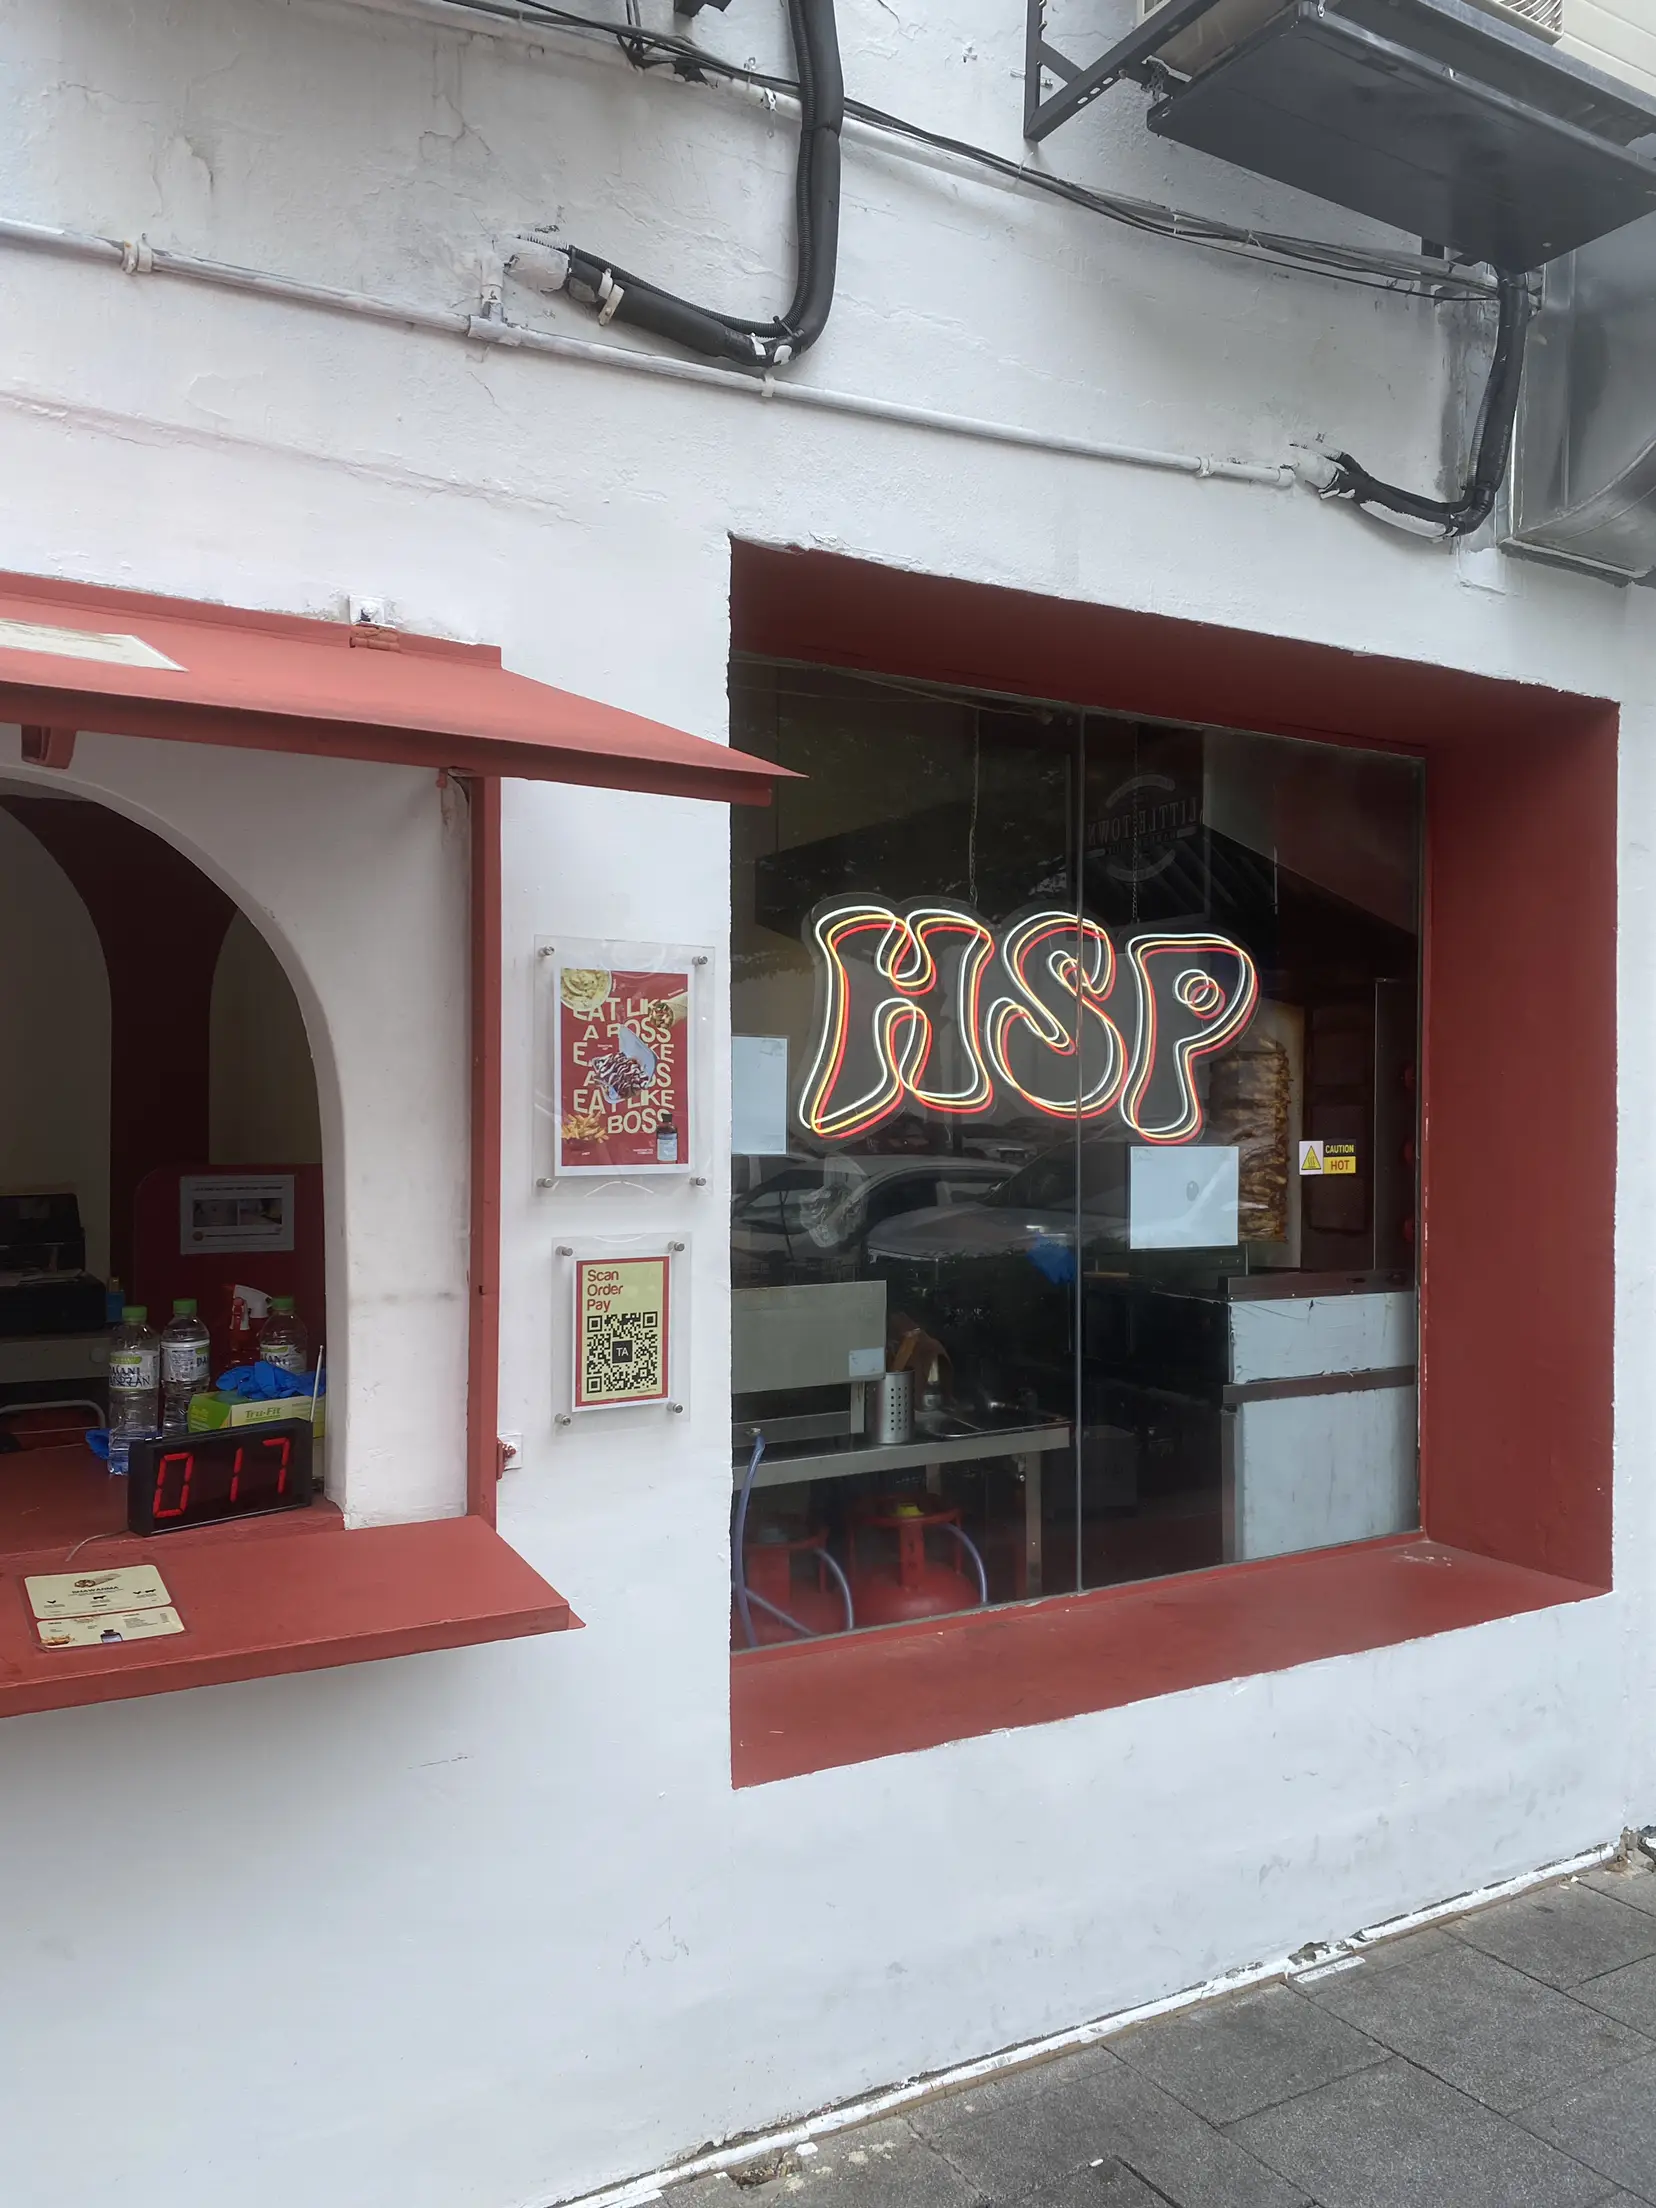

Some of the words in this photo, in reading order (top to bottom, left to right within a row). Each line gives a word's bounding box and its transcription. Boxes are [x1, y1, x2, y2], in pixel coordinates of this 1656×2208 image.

[799, 905, 1258, 1145] HSP
[583, 1024, 600, 1041] A
[1325, 1144, 1355, 1154] CAUTION
[1330, 1160, 1350, 1171] HOT
[587, 1269, 619, 1282] Scan
[587, 1284, 624, 1297] Order
[587, 1299, 611, 1313] Pay
[153, 1437, 290, 1518] 017
